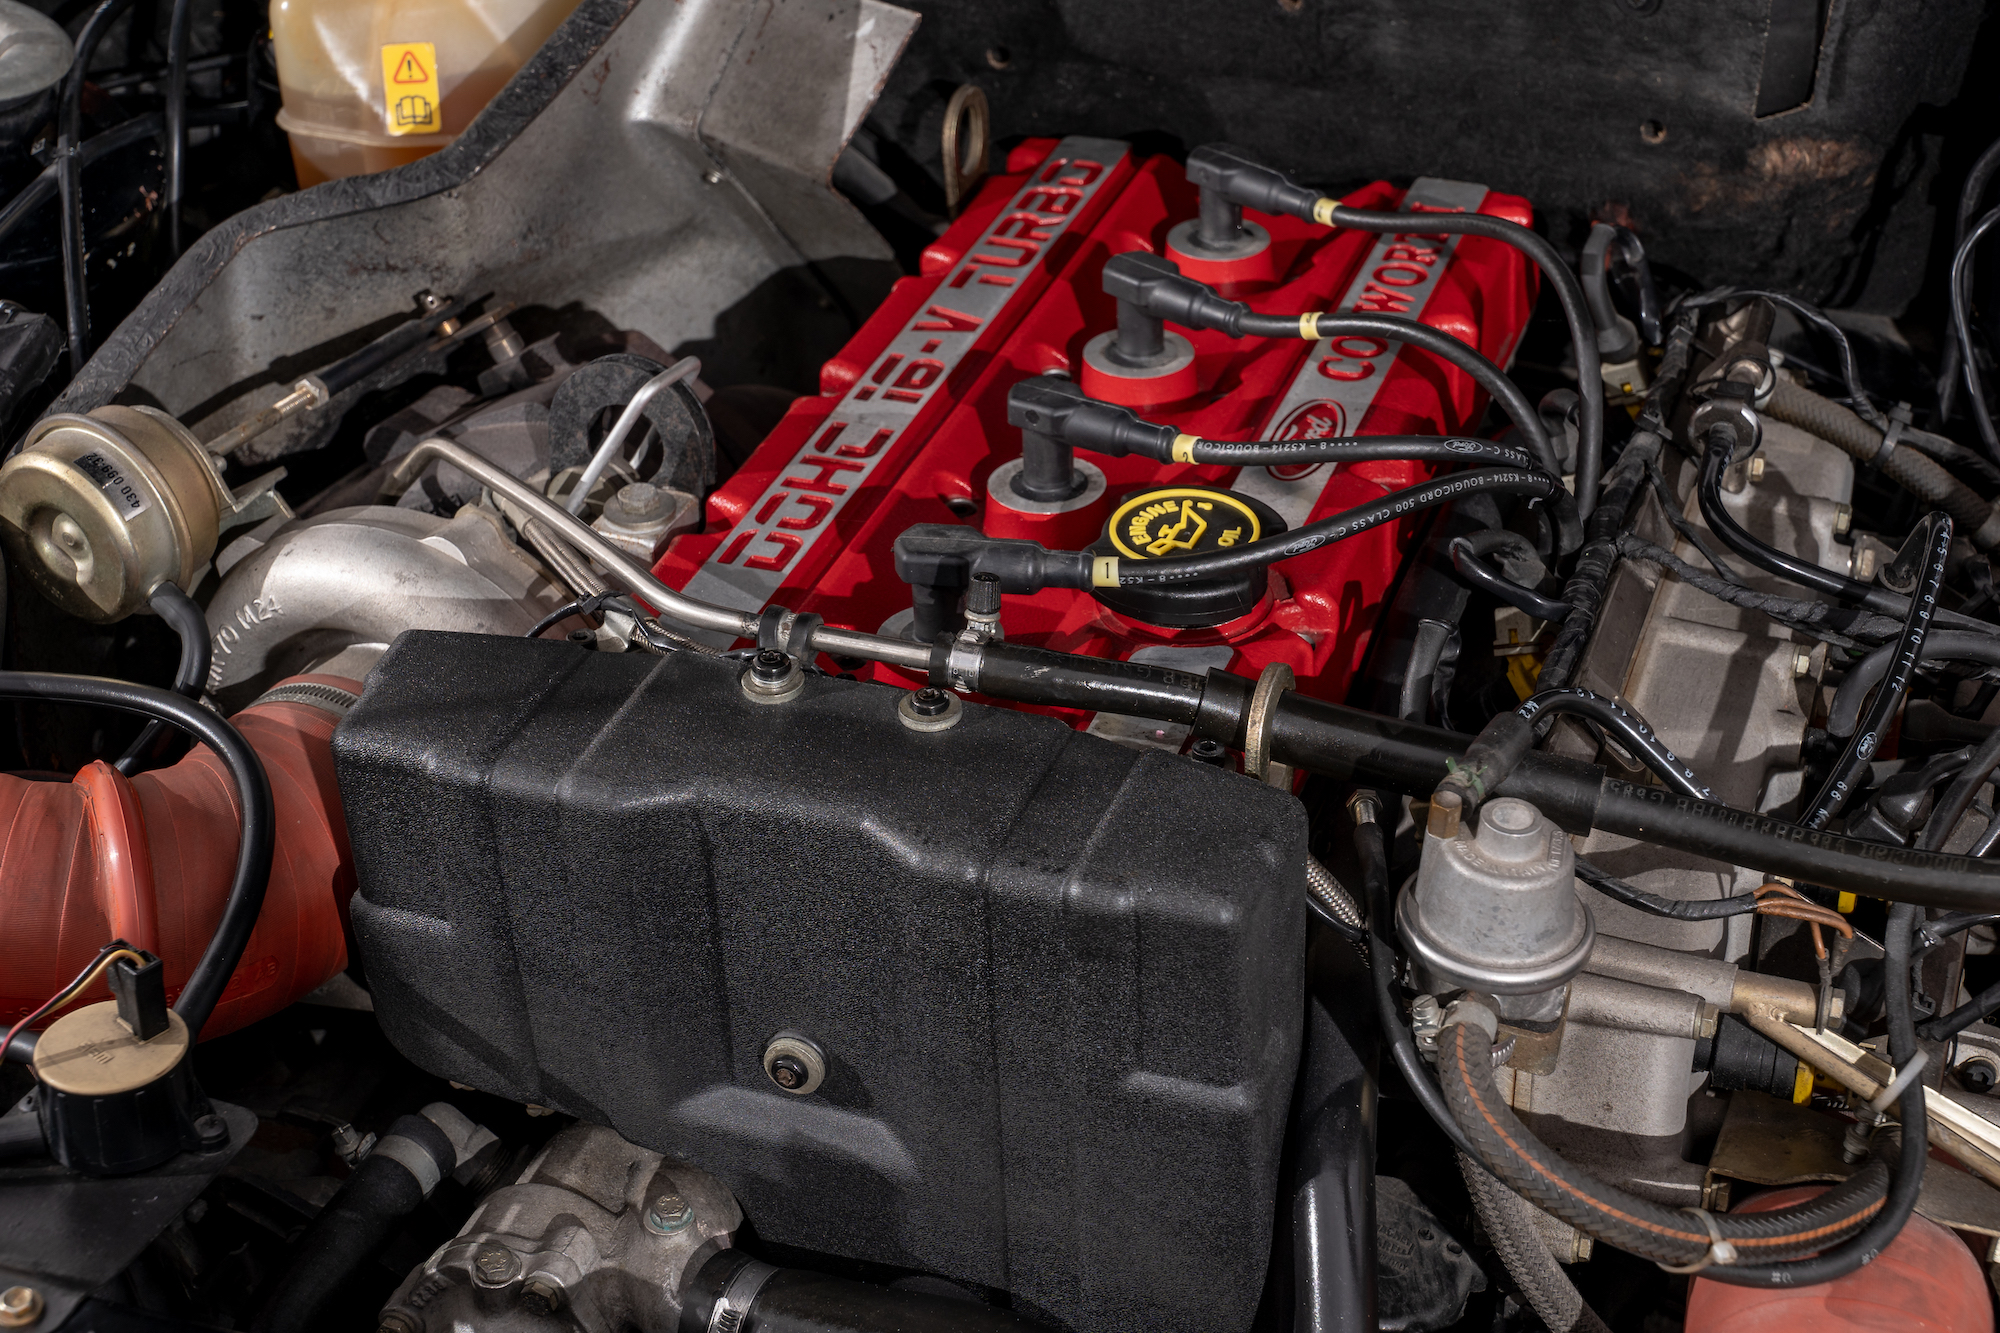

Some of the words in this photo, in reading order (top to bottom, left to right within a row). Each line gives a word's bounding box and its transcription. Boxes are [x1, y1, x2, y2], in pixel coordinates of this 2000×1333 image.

[717, 421, 895, 572] DOHC
[854, 303, 986, 405] 16-V
[948, 156, 1105, 288] TURBO
[1193, 438, 1260, 454] BOUGICOR
[1271, 442, 1307, 453] K5214
[1493, 472, 1520, 483] K5214
[121, 486, 140, 508] 430
[1419, 476, 1484, 503] BOUGICORD
[1395, 497, 1415, 513] 500
[1129, 498, 1180, 548] ENGINE
[1217, 526, 1243, 549] OIL
[1351, 508, 1390, 531] CLASS
[1104, 562, 1110, 579] 1
[1924, 594, 1935, 604] 8
[235, 594, 285, 630] M24
[1919, 610, 1930, 620] 9
[1910, 627, 1925, 645] 10
[1901, 651, 1916, 668] 11
[1891, 673, 1906, 692] 12
[1453, 839, 1485, 867] MADE
